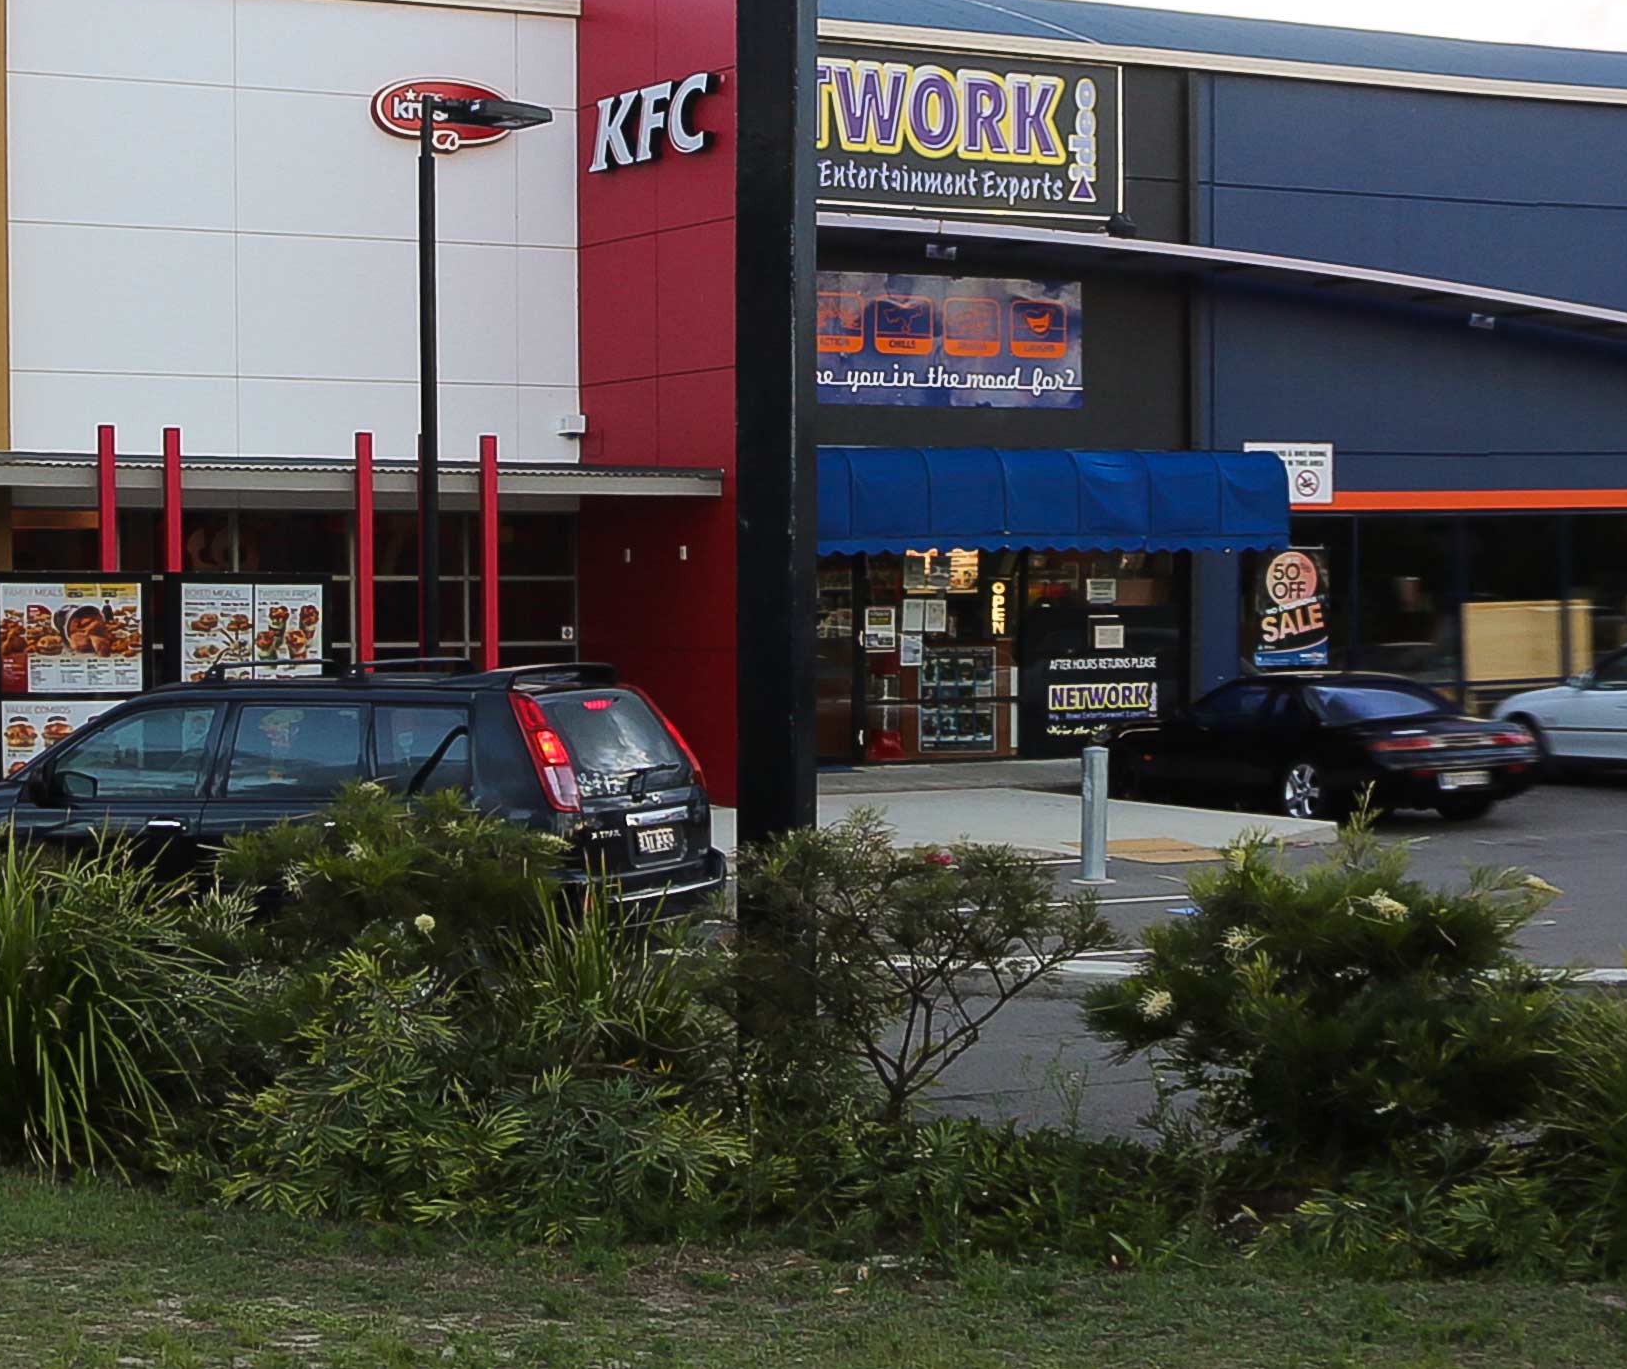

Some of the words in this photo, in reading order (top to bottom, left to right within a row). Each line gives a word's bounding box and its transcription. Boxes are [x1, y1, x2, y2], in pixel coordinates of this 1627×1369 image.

[588, 72, 709, 173] KFC
[817, 158, 978, 197] Entertainment
[980, 170, 1064, 206] Experts
[888, 339, 917, 350] CHILLS
[847, 369, 888, 393] you
[891, 364, 917, 387] in
[926, 365, 960, 388] the
[964, 367, 1022, 389] mood
[1031, 368, 1076, 396] for?
[1272, 581, 1306, 599] OFF
[991, 581, 1006, 635] OPEN
[1261, 603, 1325, 643] SALE
[1049, 659, 1072, 670] AFTER
[1073, 658, 1097, 670] HOURS
[1098, 658, 1131, 669] RETURNS
[1132, 656, 1157, 669] PLEASE
[1049, 683, 1149, 710] NETWORK
